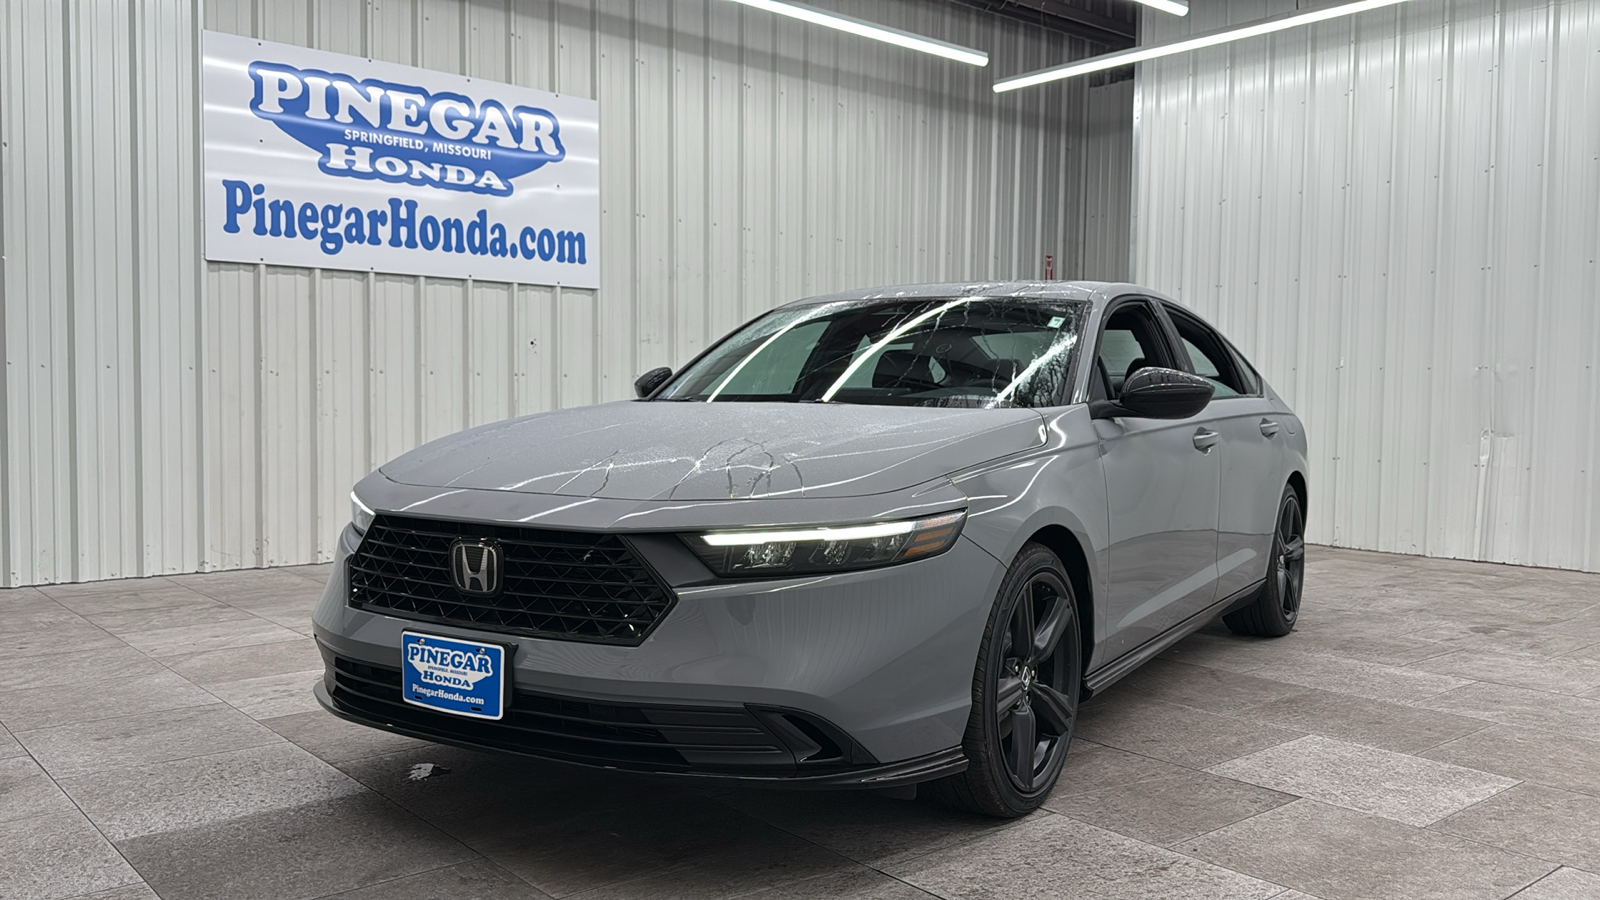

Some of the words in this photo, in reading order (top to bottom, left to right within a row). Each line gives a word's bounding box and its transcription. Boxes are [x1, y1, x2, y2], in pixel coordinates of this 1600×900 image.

[256, 68, 560, 157] PINEGAR
[344, 128, 430, 153] SPRINGFIELD,
[432, 141, 492, 161] MISSOURI
[325, 143, 508, 191] HONDA
[222, 179, 587, 265] PinegarHonda.com
[409, 645, 490, 674] PINEGAR
[412, 683, 485, 705] PinegarHonda.com
[423, 670, 472, 688] HONDA
